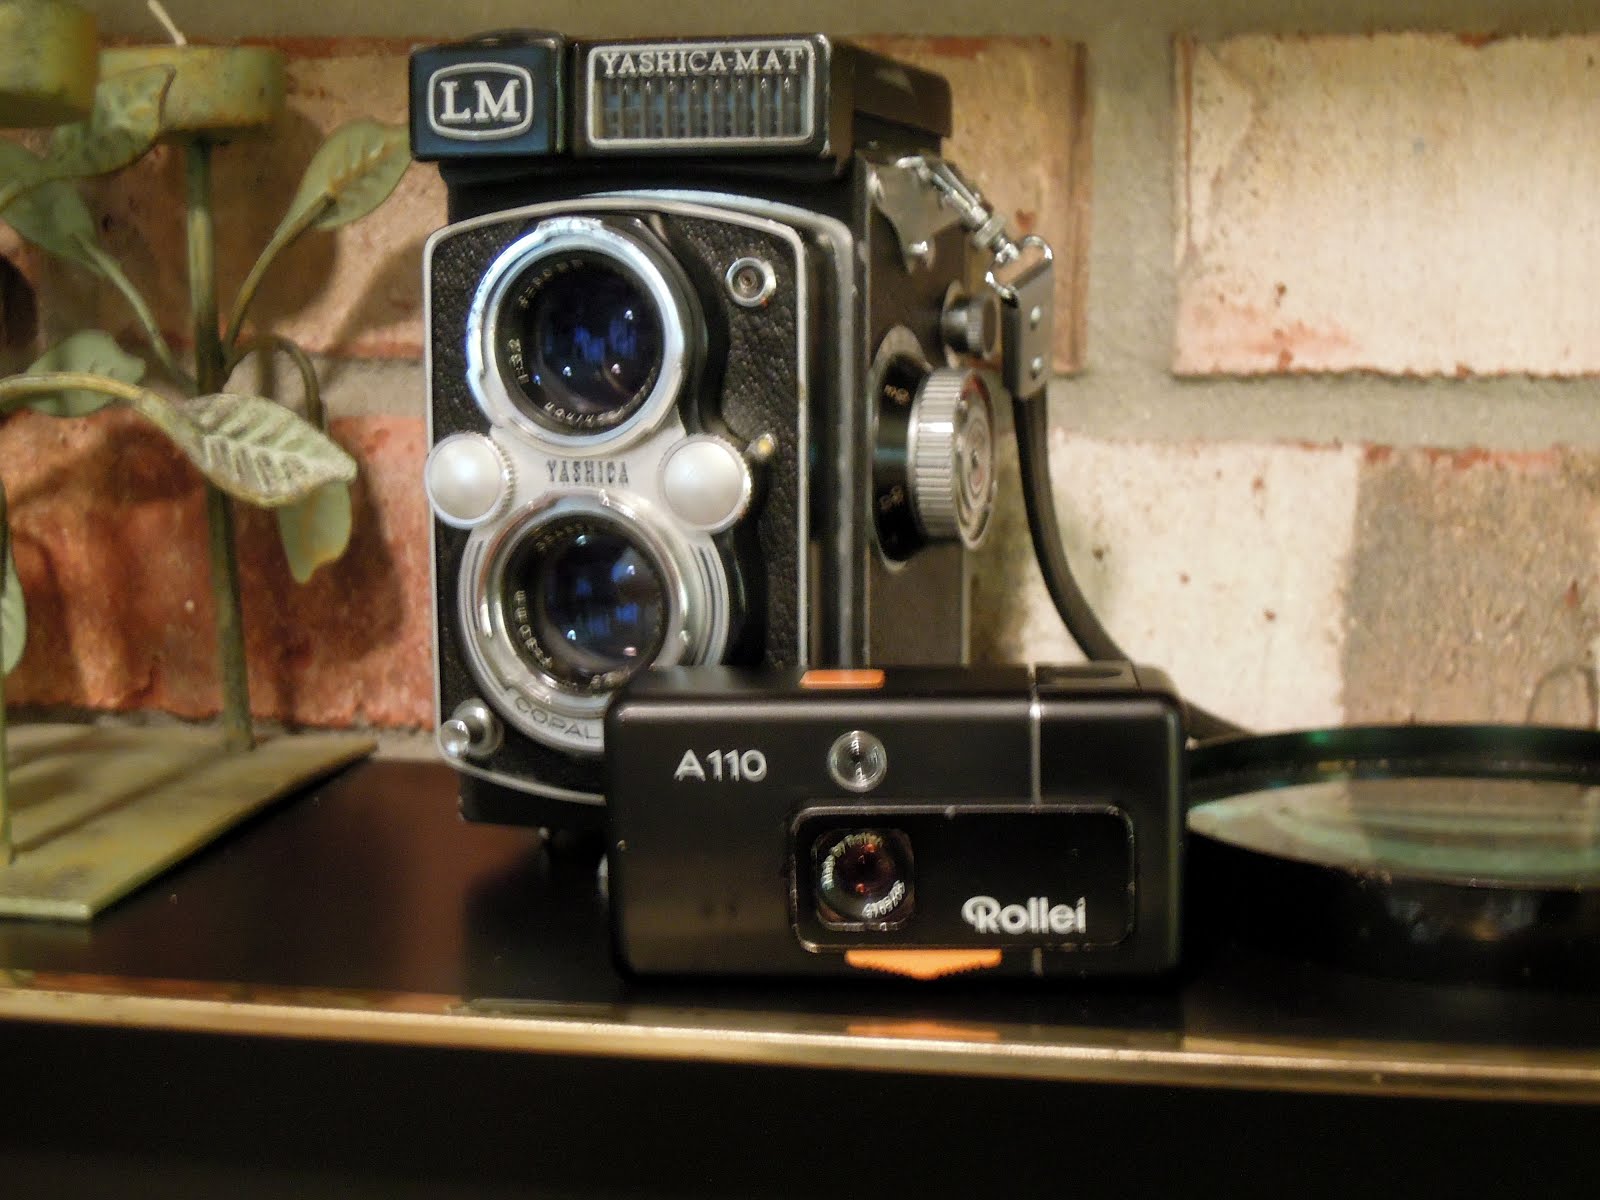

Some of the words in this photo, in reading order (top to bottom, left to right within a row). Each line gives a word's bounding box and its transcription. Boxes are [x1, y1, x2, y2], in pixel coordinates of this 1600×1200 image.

[602, 48, 803, 76] YASHICA-MAT
[440, 80, 521, 124] LM
[547, 460, 629, 484] YASHICA
[515, 697, 601, 739] COPAL
[673, 749, 768, 782] A110
[961, 895, 1087, 934] Rollei
